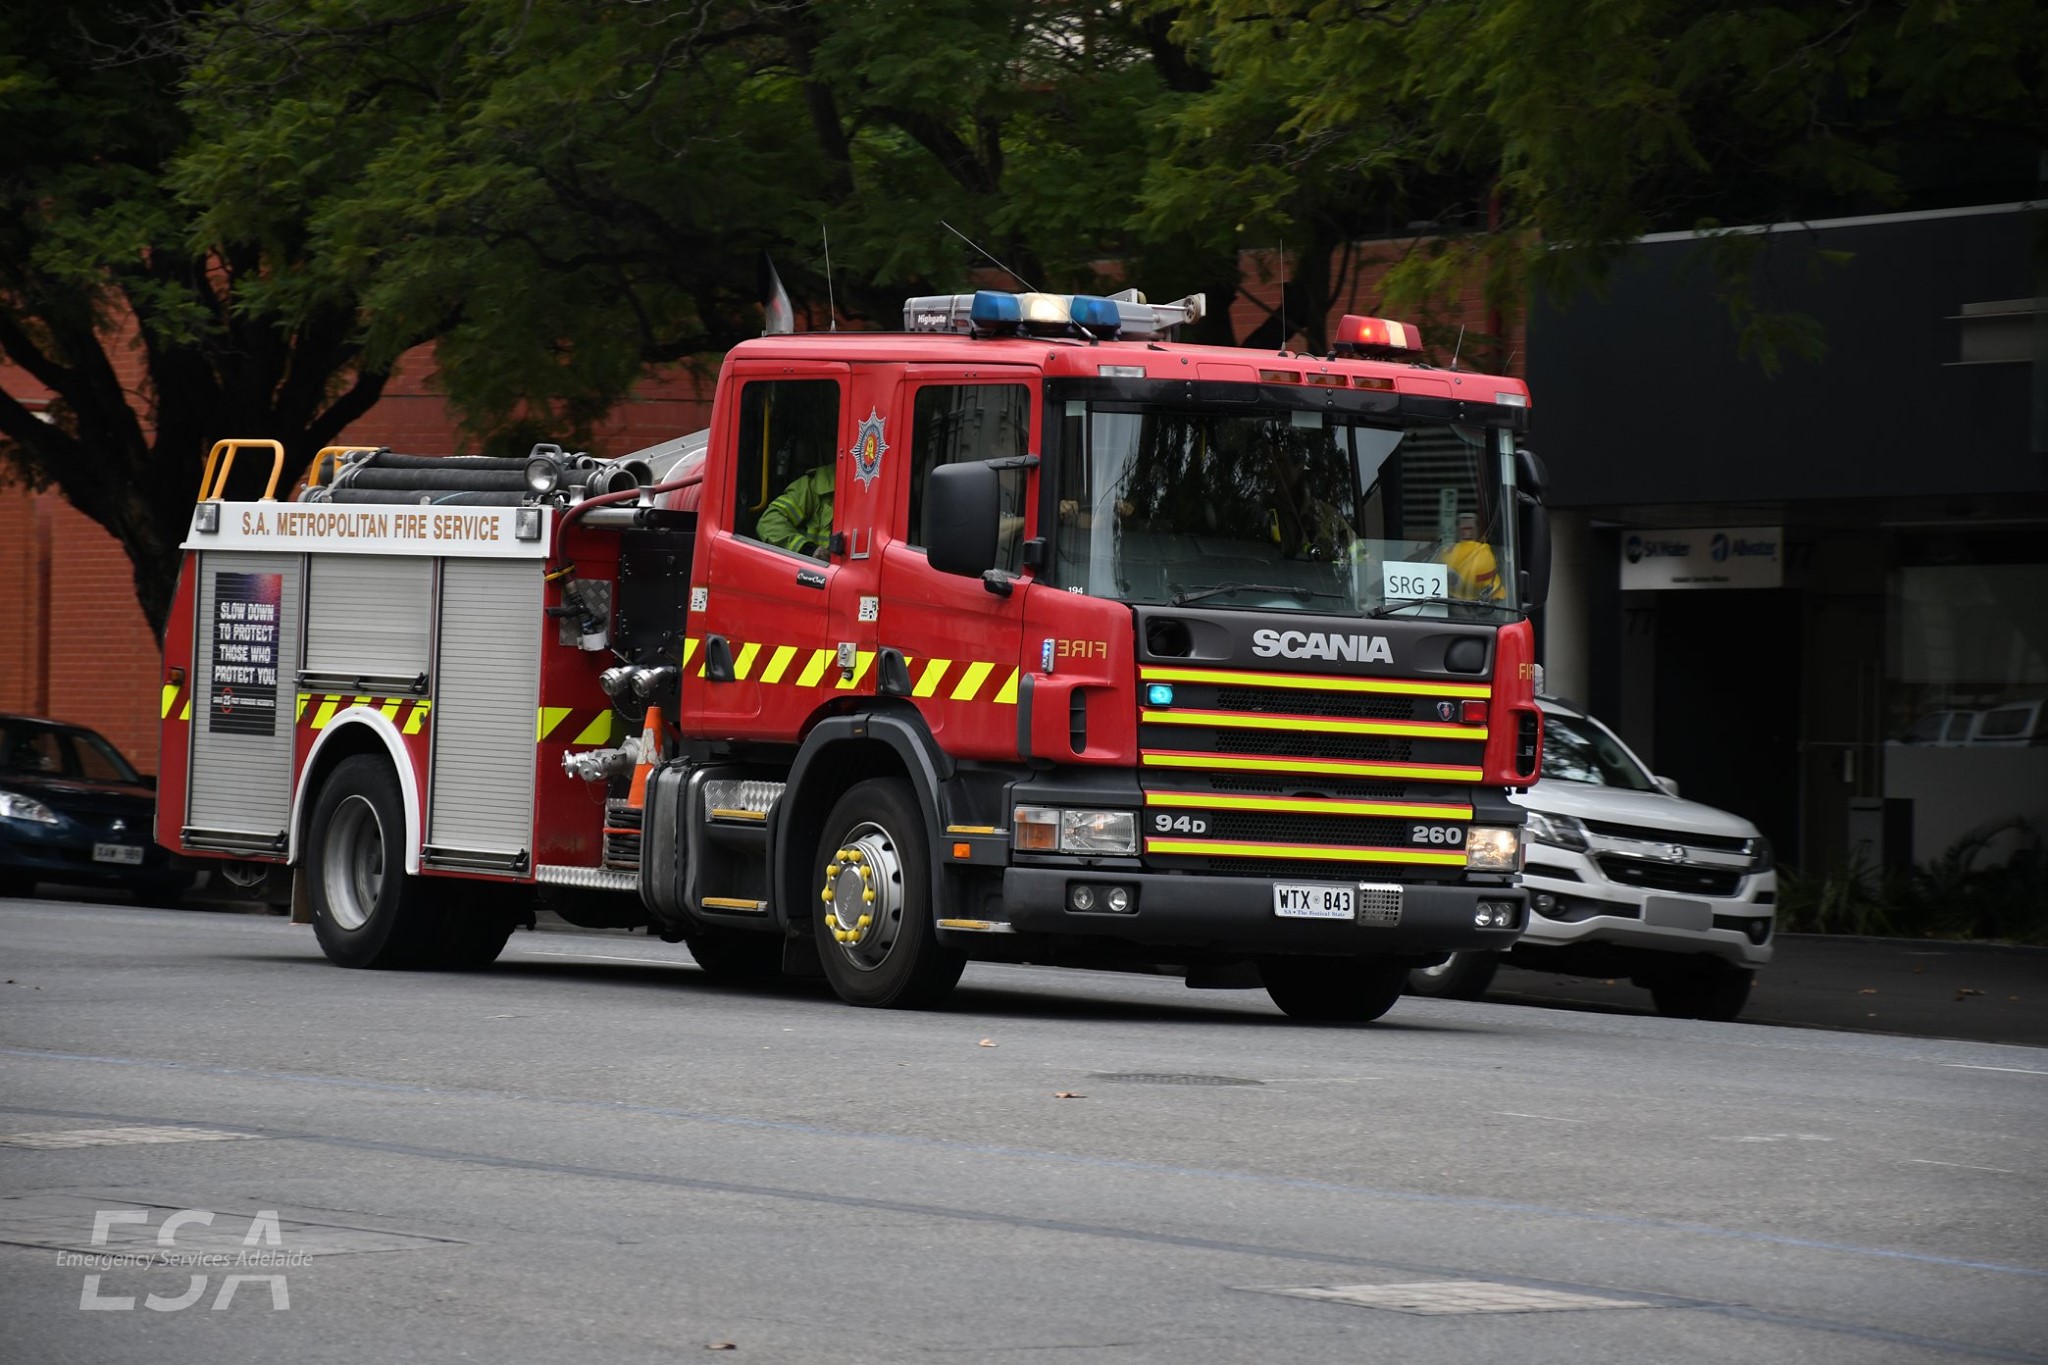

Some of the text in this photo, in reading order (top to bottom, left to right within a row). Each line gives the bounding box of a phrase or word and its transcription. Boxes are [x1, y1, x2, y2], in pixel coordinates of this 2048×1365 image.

[917, 313, 947, 326] Highgate
[242, 511, 499, 541] S.A. METROPOLITAN FIRE SERVICE
[1068, 586, 1083, 595] 194
[1389, 575, 1441, 596] SRG 2
[220, 602, 275, 621] SLOW DOWN
[219, 623, 274, 642] TO PROTECT
[219, 644, 271, 664] THOSE WHO
[1252, 629, 1394, 664] SCANIA
[214, 665, 255, 684] PROTECT
[1155, 814, 1206, 833] 94D
[1412, 825, 1462, 845] 260
[1279, 889, 1350, 911] WTX 843
[1297, 909, 1308, 917] The
[1309, 910, 1330, 918] Festival
